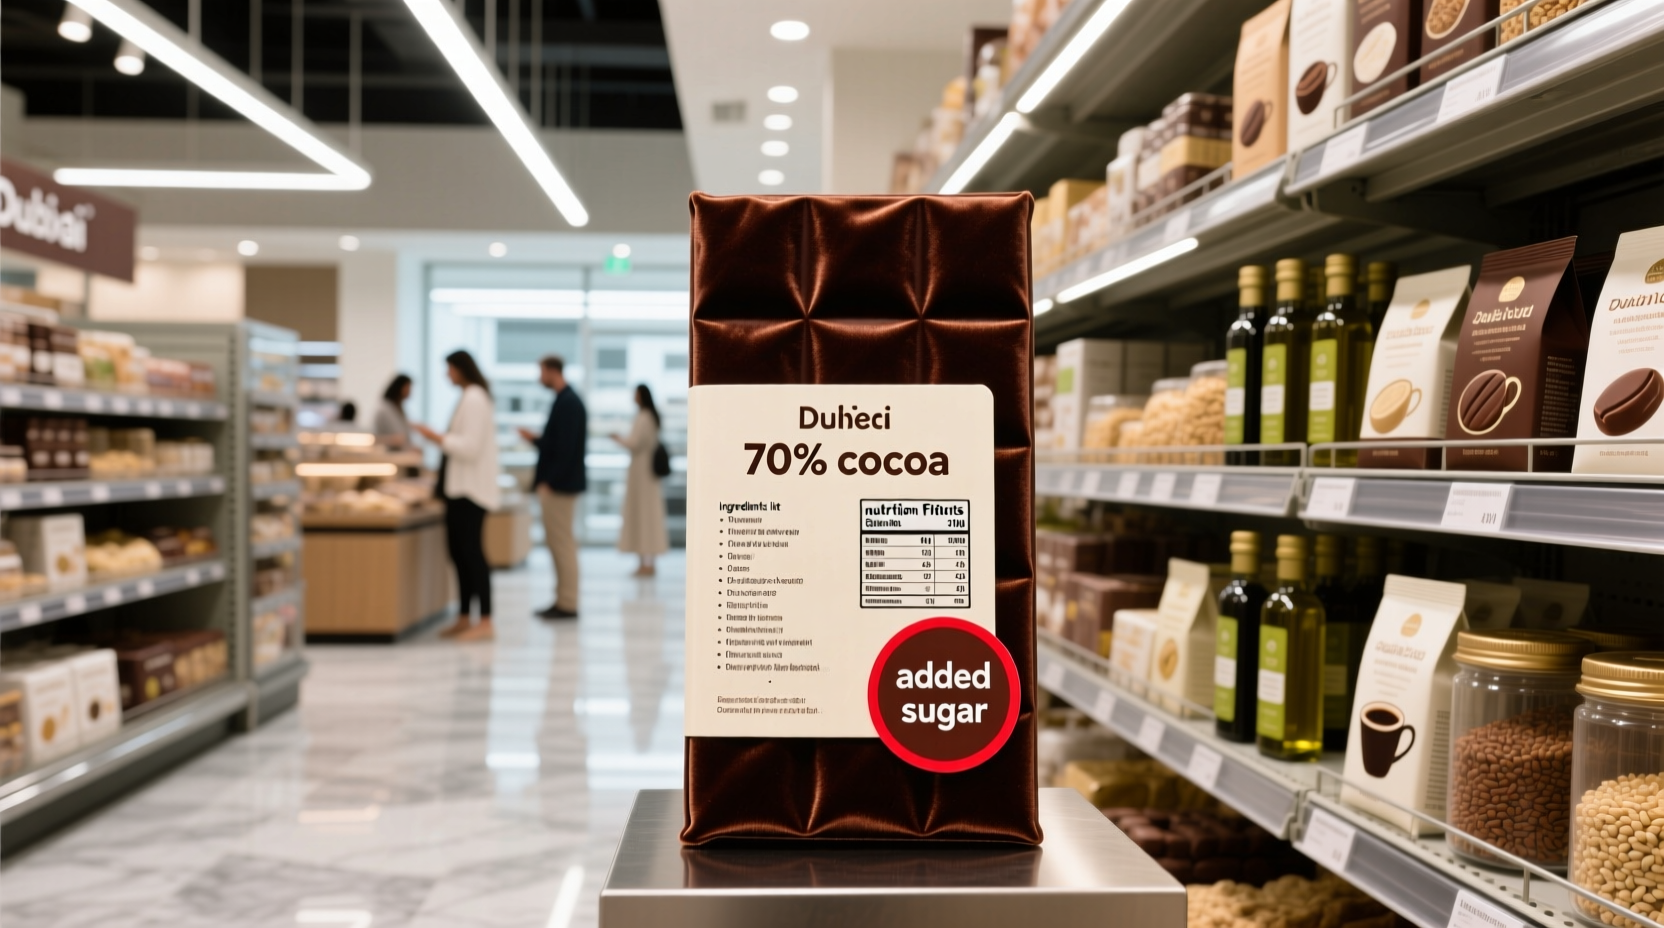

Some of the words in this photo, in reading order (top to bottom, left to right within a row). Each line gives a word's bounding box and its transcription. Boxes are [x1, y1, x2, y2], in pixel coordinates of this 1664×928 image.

[744, 442, 828, 476] 70%
[837, 451, 949, 476] cocoa
[895, 660, 991, 689] added
[901, 702, 988, 731] sugar
